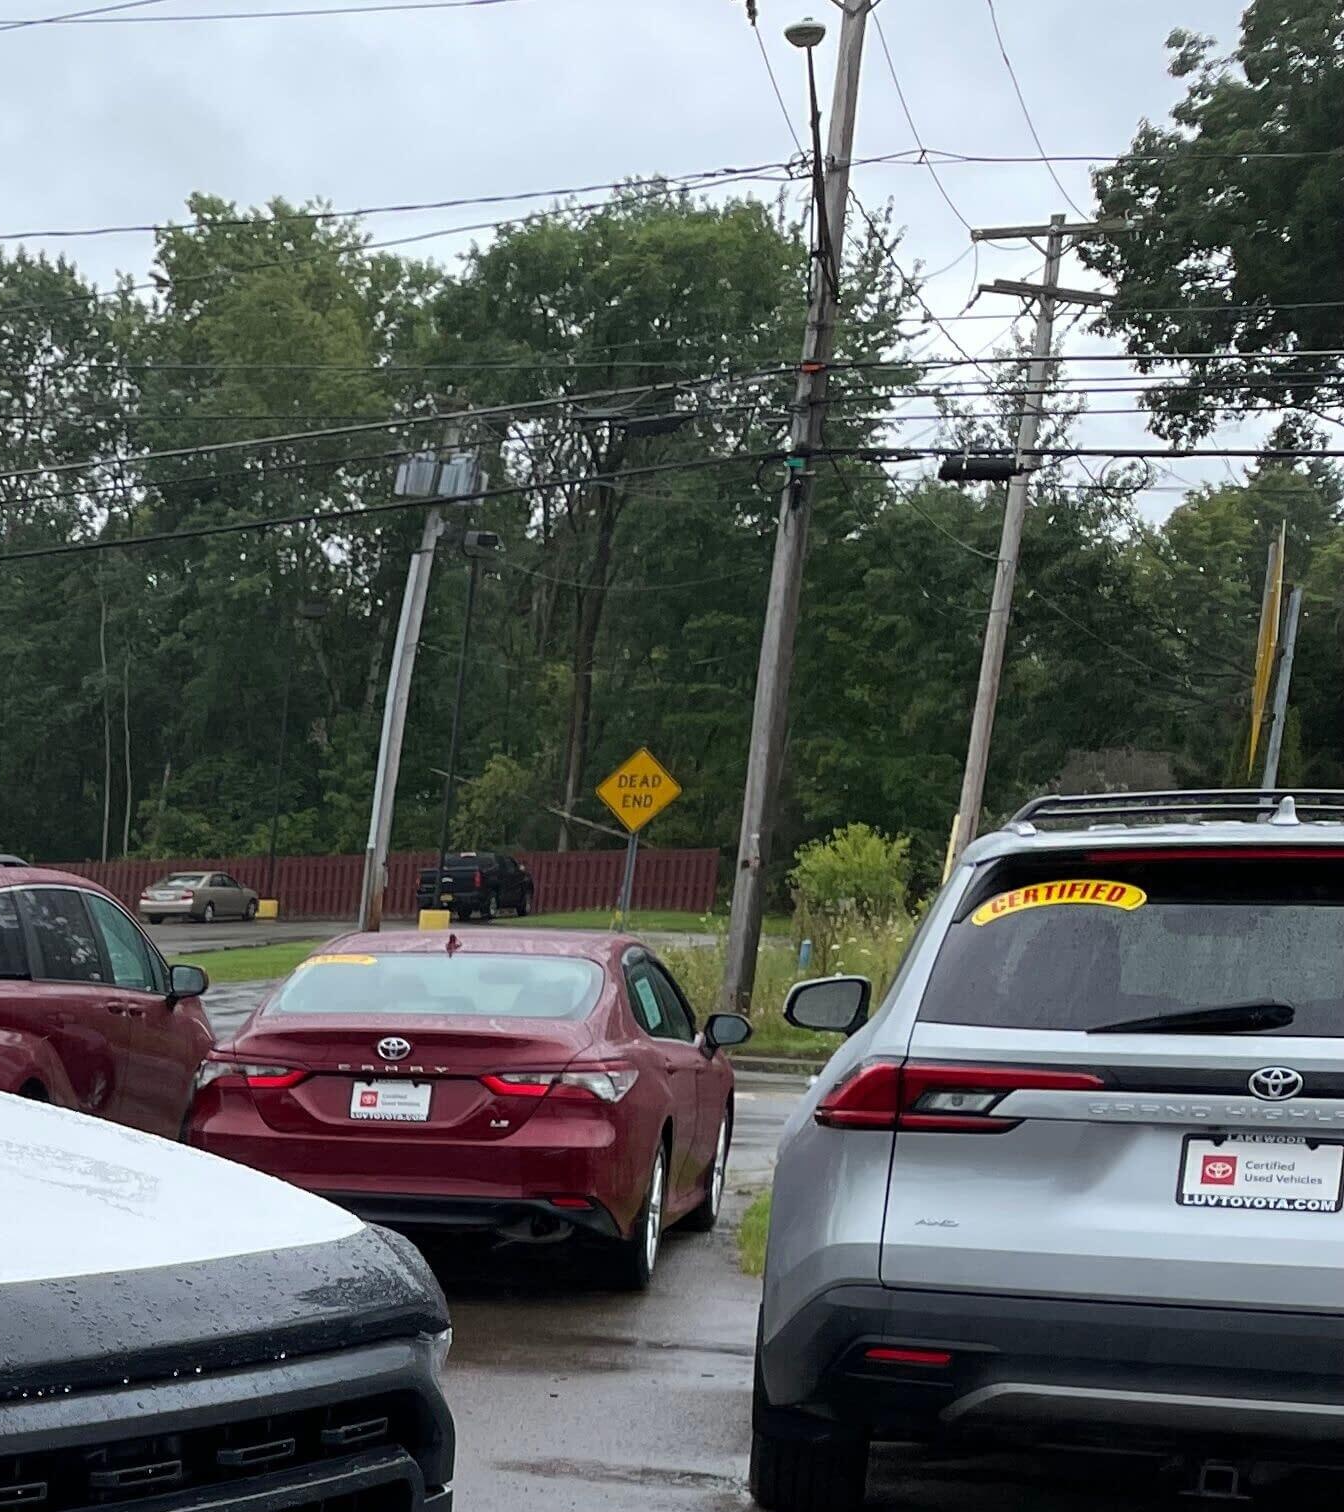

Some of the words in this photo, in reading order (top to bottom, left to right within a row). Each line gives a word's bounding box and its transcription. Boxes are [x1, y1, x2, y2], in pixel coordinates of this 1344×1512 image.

[617, 773, 662, 788] DEAD
[622, 794, 653, 808] END
[991, 882, 1127, 913] CERTIFIED
[1088, 1102, 1212, 1119] GRAND
[1227, 1133, 1306, 1144] LAKEWOOD
[1245, 1160, 1296, 1172] Certified
[1244, 1173, 1273, 1183] Used
[1276, 1174, 1323, 1185] Vehicles
[1183, 1194, 1336, 1211] LUVTOYOTA.COM
